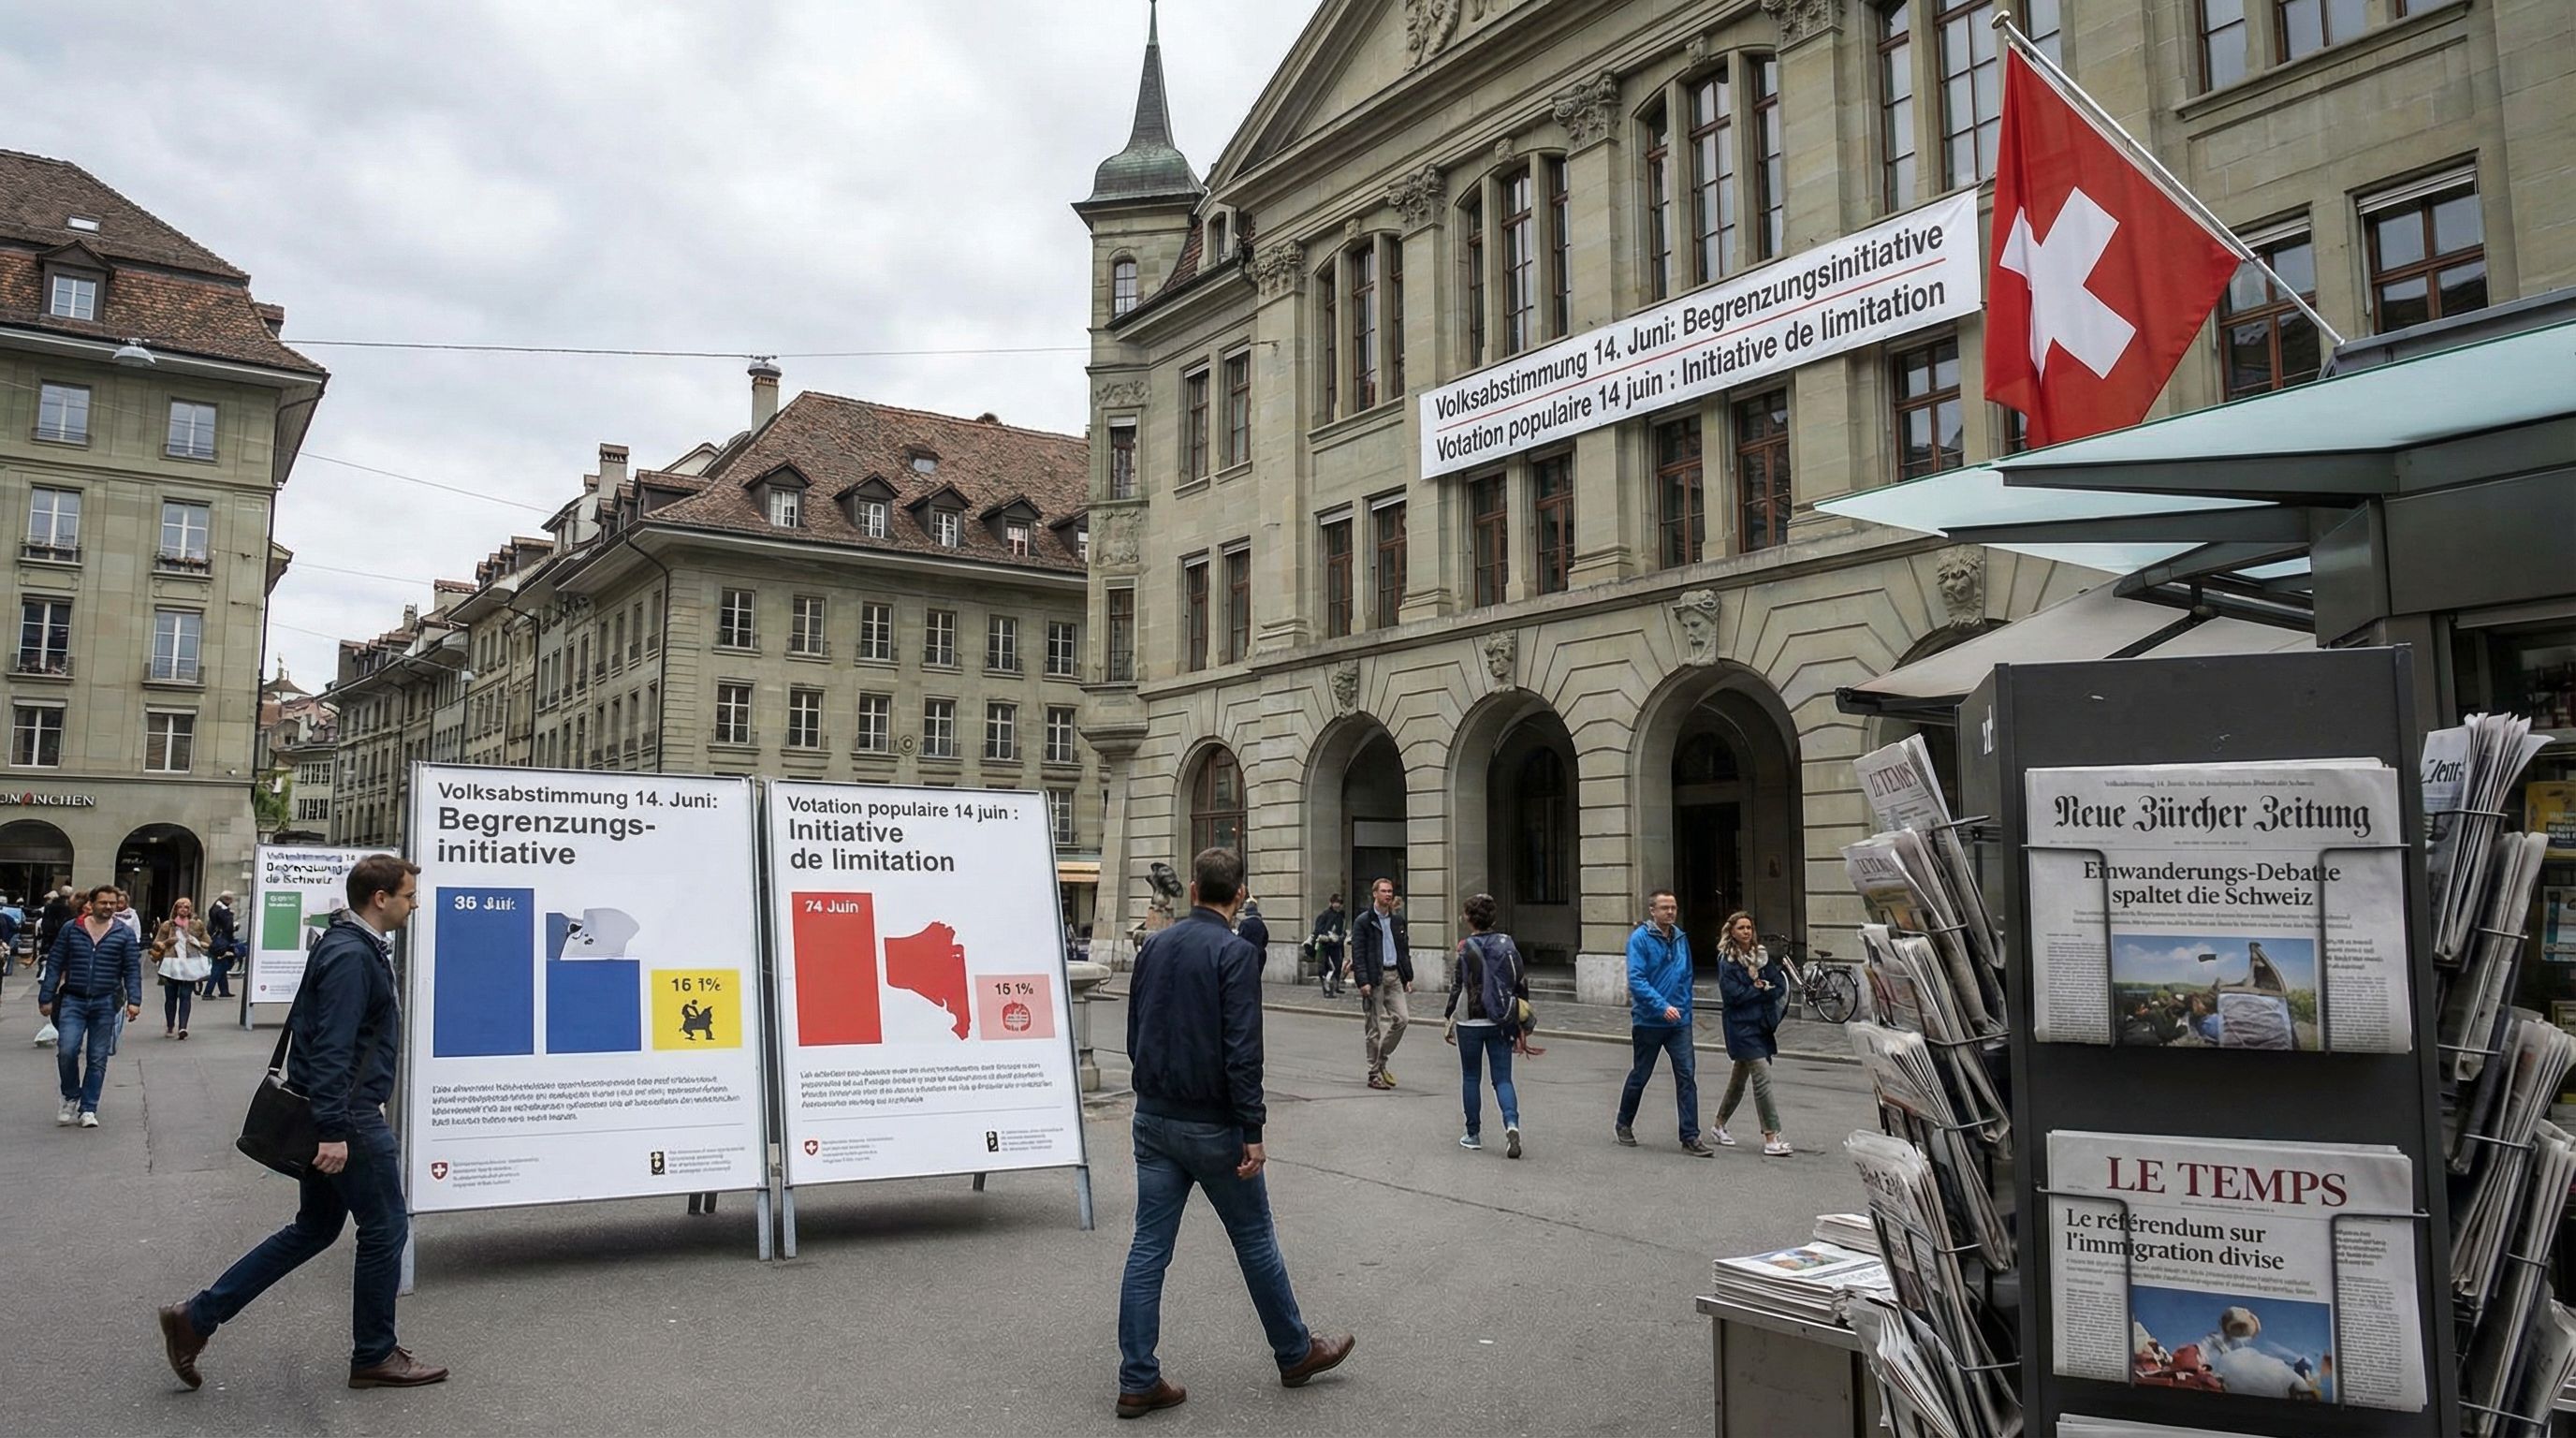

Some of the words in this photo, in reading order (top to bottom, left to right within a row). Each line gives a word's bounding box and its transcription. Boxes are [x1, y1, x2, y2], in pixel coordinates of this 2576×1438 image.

[1435, 349, 1588, 420] Volksabstimmung
[1594, 335, 1620, 364] 14.
[1628, 320, 1676, 356] Juni:
[1684, 222, 1943, 336] Begrenzungsinitiative
[1436, 424, 1503, 462] Votation
[1509, 394, 1592, 446] populaire
[1599, 384, 1620, 411] 14
[1626, 372, 1663, 411] juin
[1683, 336, 1777, 386] Initiative
[1785, 320, 1813, 351] de
[1822, 279, 1944, 340] limitation
[438, 782, 628, 809] Volksabstimmung
[636, 790, 663, 807] 14.
[669, 792, 718, 809] Juni:
[438, 806, 655, 841] Begrenzungs-
[787, 796, 862, 814] Votation
[869, 800, 948, 824] populaire
[955, 804, 973, 818] 14
[977, 805, 1008, 822] juin
[2055, 795, 2125, 829] Neue
[2132, 795, 2247, 833] Zürcher
[2254, 795, 2371, 837] Zeitung
[789, 819, 903, 843] Initiative
[438, 839, 576, 864] initiative
[790, 848, 822, 869] de
[832, 848, 955, 872] limitation
[827, 900, 858, 913] Juin
[2113, 888, 2182, 907] spaltet
[2188, 888, 2220, 905] die
[2225, 888, 2313, 905] Schweiz
[2107, 1156, 2165, 1194] LE
[2177, 1163, 2348, 1206] TEMPS
[2067, 1209, 2092, 1228] Le
[2098, 1211, 2225, 1241] référendum
[2231, 1226, 2266, 1243] sur
[2219, 1245, 2284, 1270] divise
